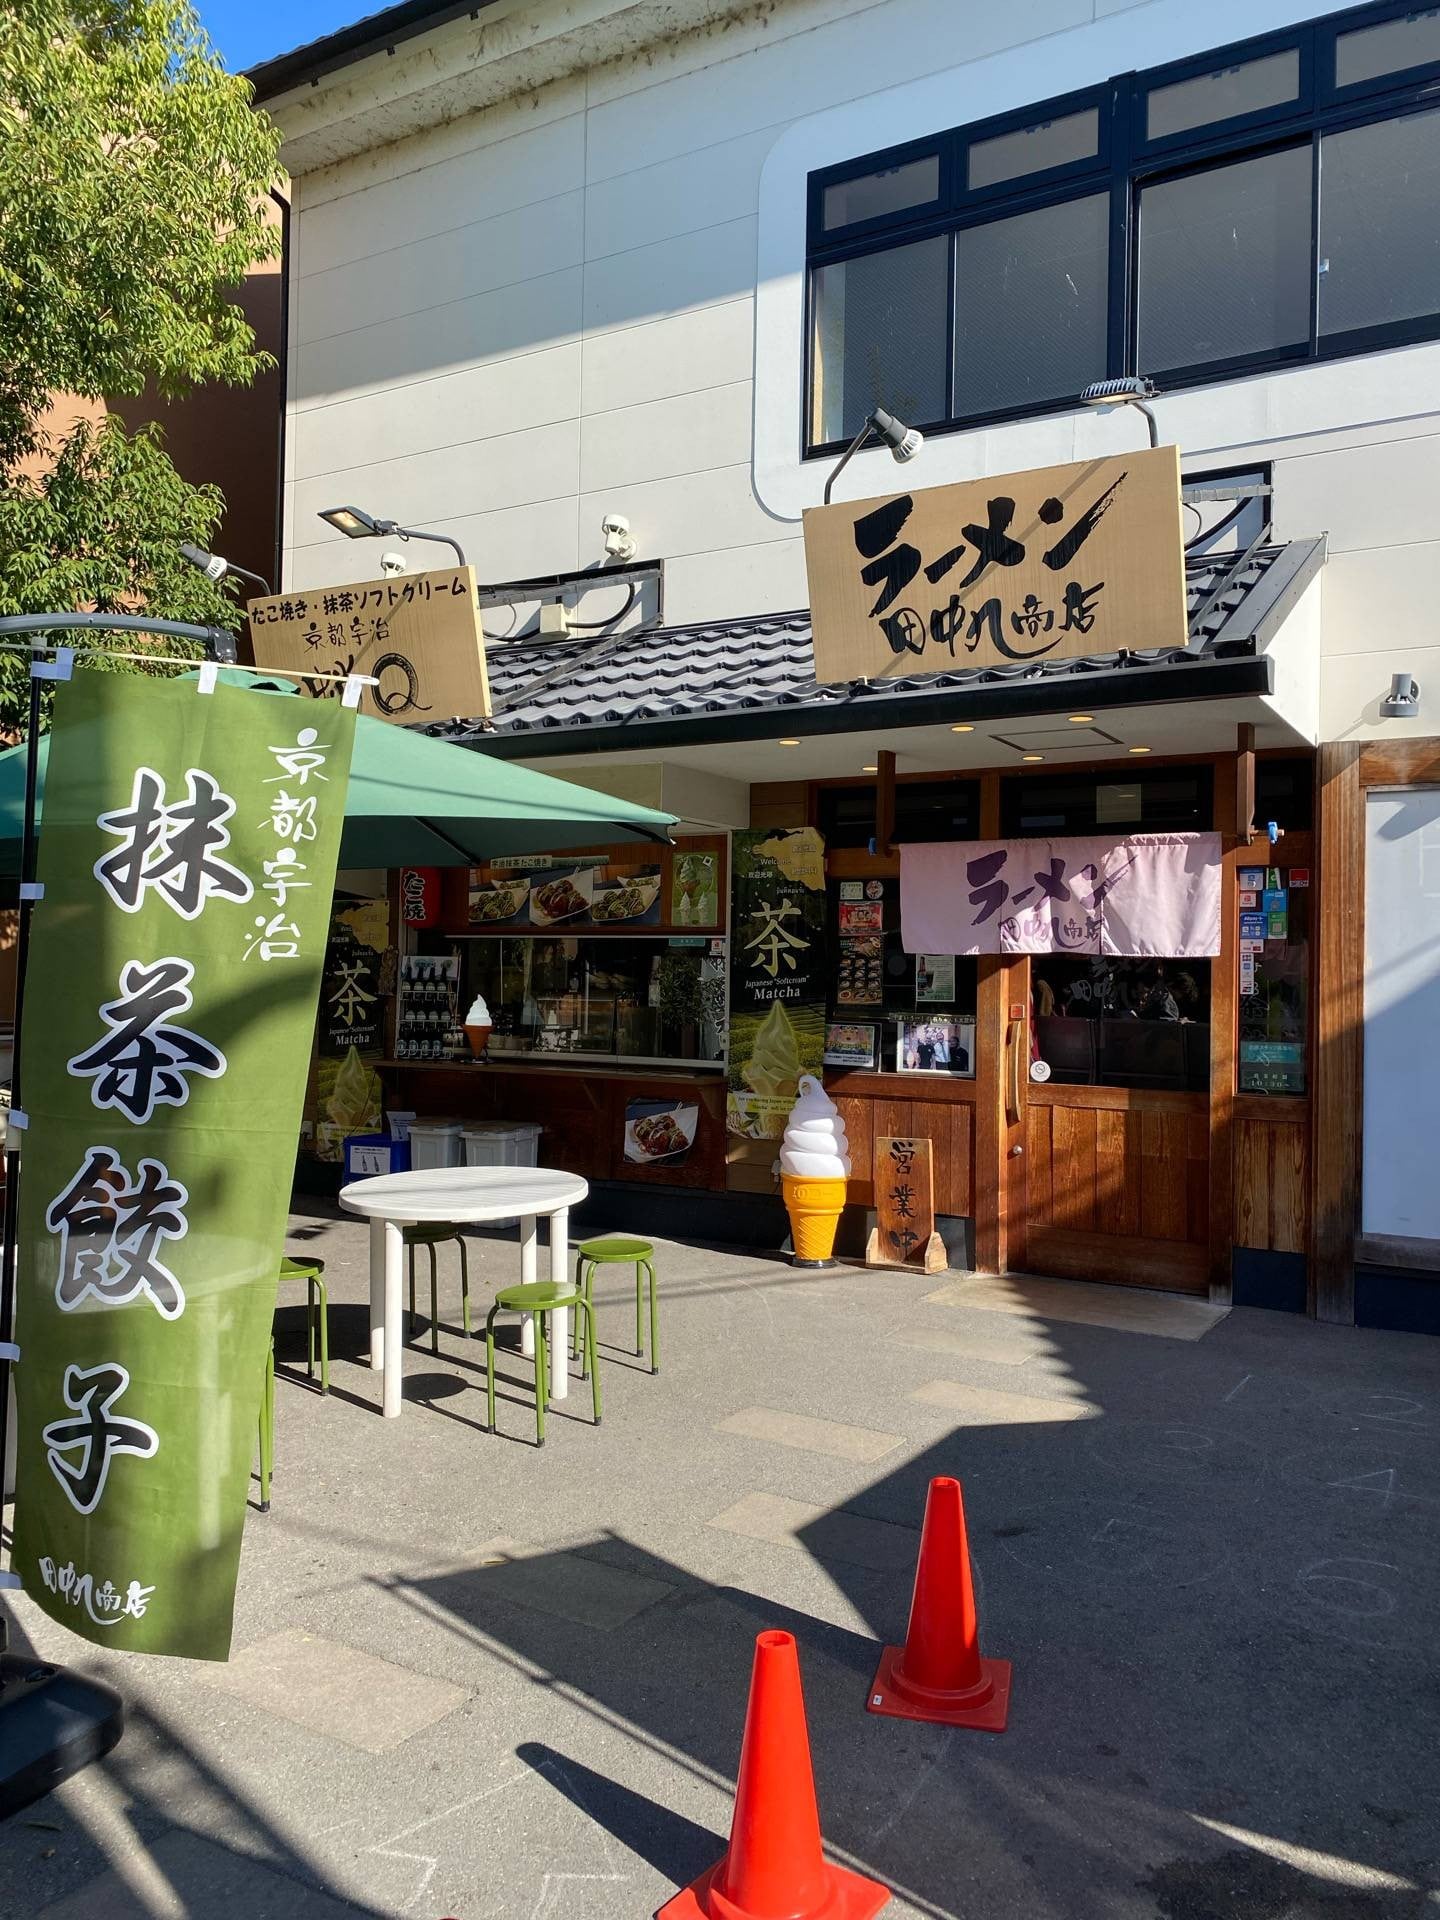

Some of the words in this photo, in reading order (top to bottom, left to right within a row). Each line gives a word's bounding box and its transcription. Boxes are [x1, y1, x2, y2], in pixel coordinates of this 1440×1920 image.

[853, 471, 1128, 618] ラーメン
[251, 576, 468, 625] たこ焼き・抹茶ソフトクリーム
[302, 615, 391, 653] 京都宇治
[242, 727, 333, 962] 京都宇治
[966, 849, 1138, 926] ラーメン
[743, 897, 812, 978] 茶
[327, 958, 379, 1026] 茶
[753, 985, 801, 1000] Matcha
[335, 1033, 370, 1046] Matcha
[42, 767, 254, 1515] 抹茶餃子
[888, 1141, 920, 1262] 営業中
